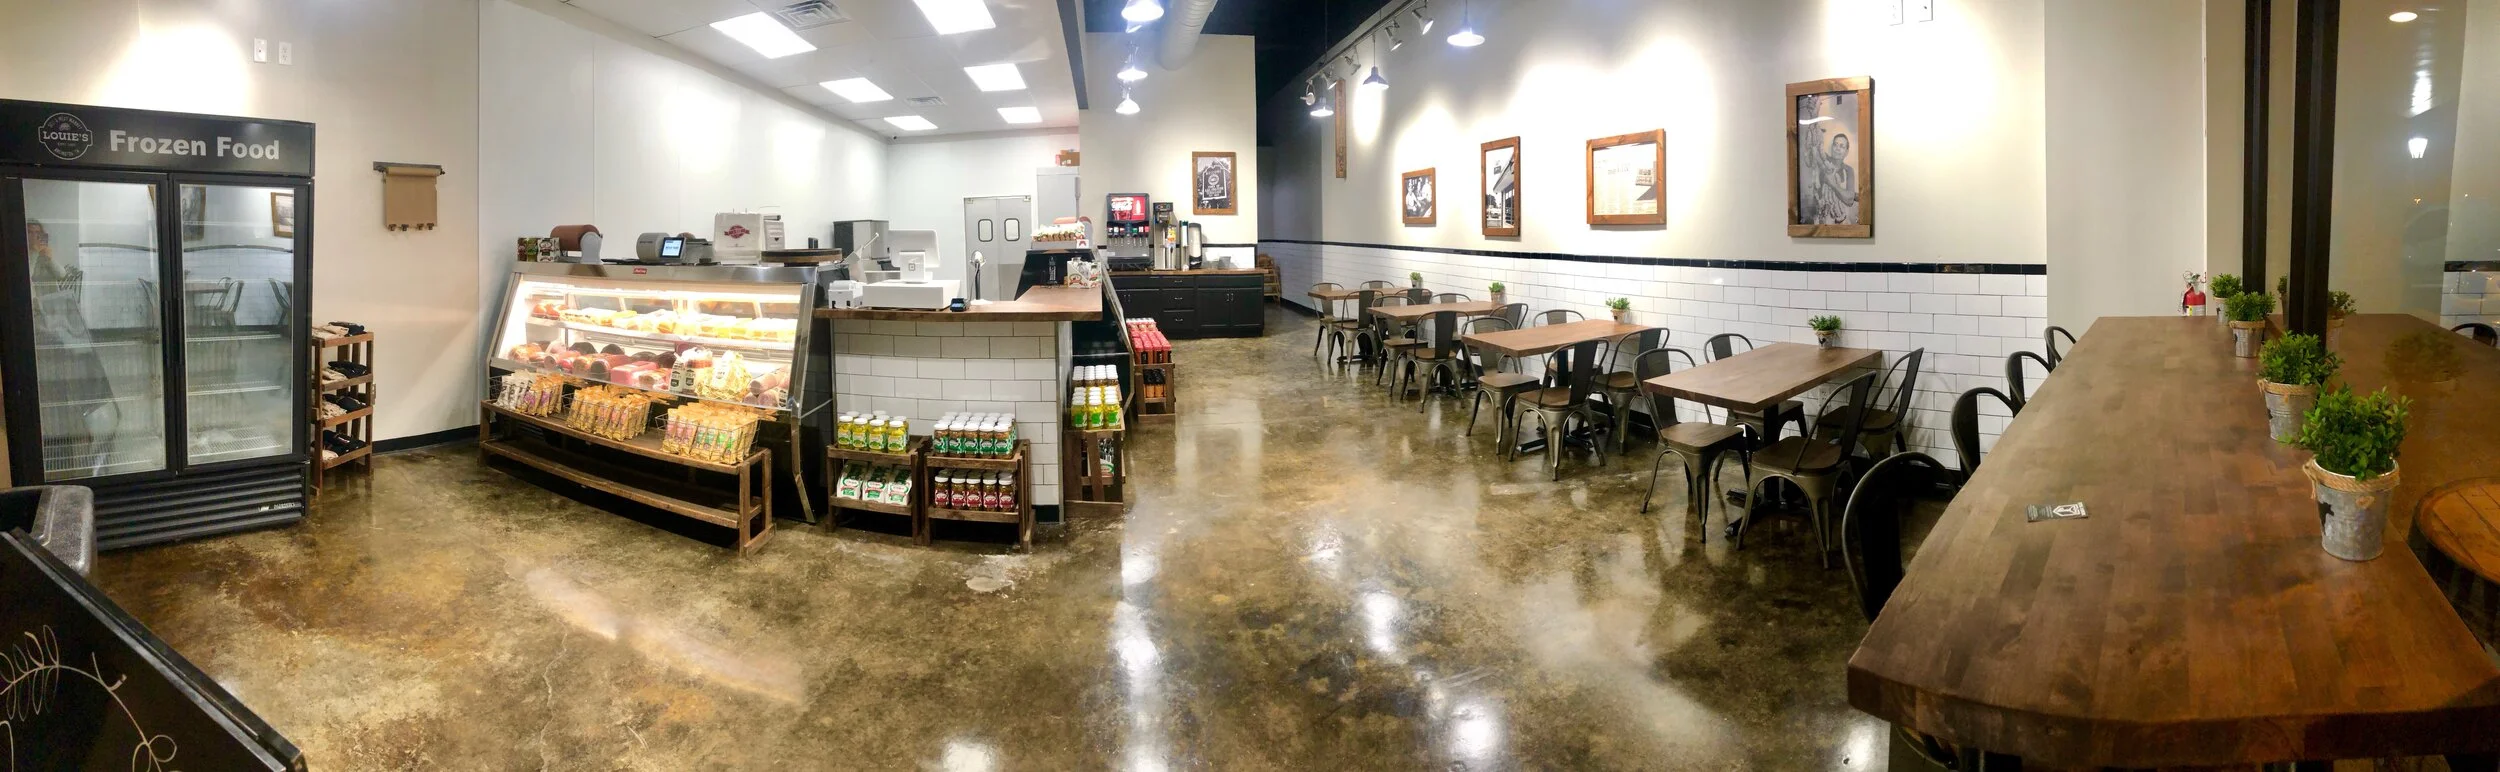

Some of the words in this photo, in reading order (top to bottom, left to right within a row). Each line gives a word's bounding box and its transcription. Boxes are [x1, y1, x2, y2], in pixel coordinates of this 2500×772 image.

[42, 130, 89, 142] LOUIE'S
[110, 129, 207, 157] Frozen
[216, 136, 280, 160] Food
